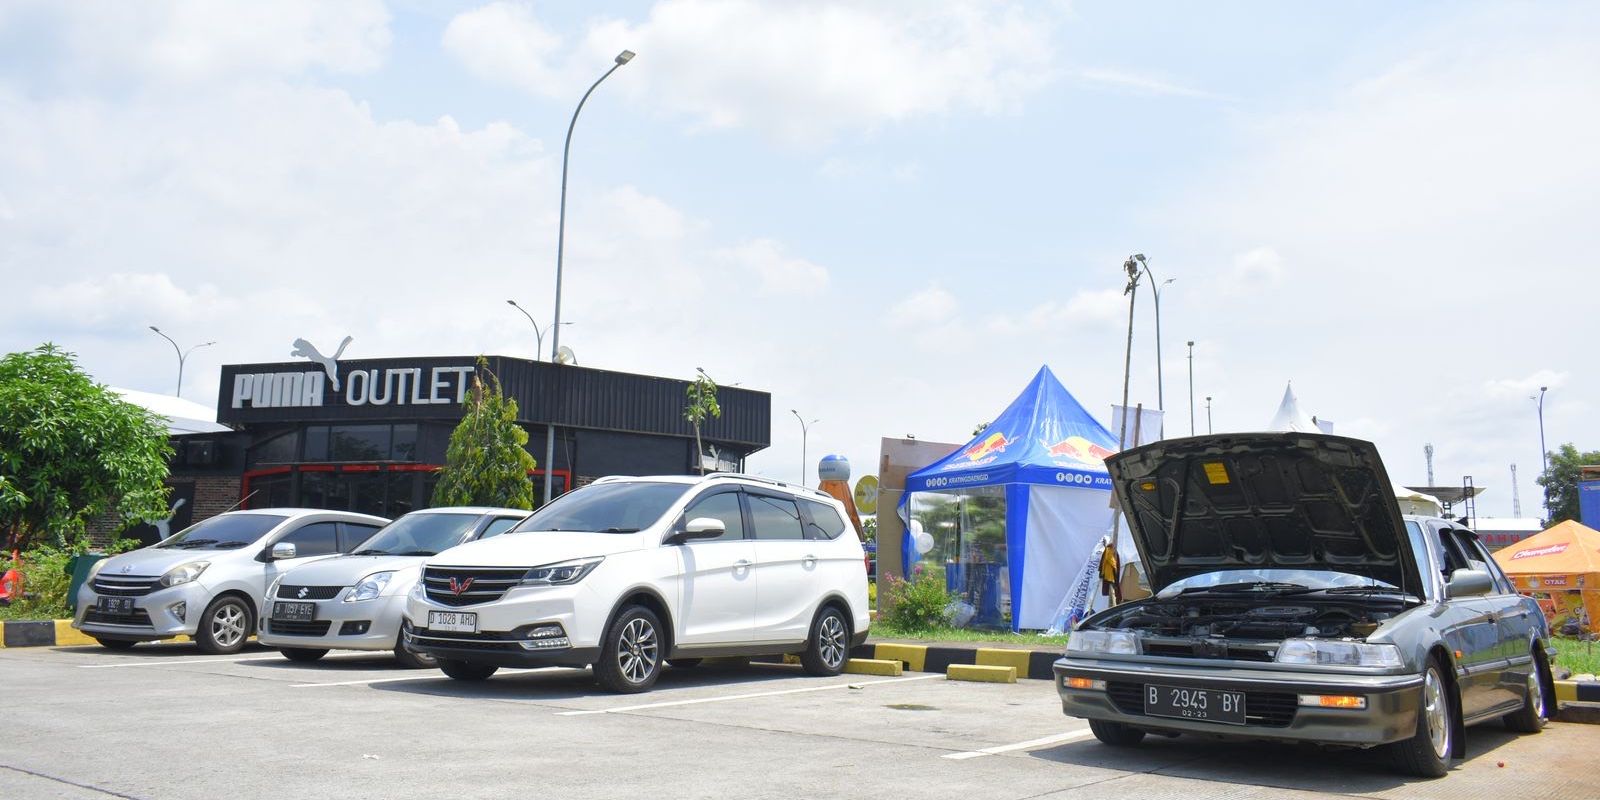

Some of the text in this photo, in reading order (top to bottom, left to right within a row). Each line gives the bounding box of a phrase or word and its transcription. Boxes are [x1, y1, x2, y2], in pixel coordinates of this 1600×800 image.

[231, 366, 474, 409] PUMA OUTLET
[429, 612, 435, 624] D
[459, 614, 475, 626] AHD
[1149, 686, 1241, 713] B 2945 BY
